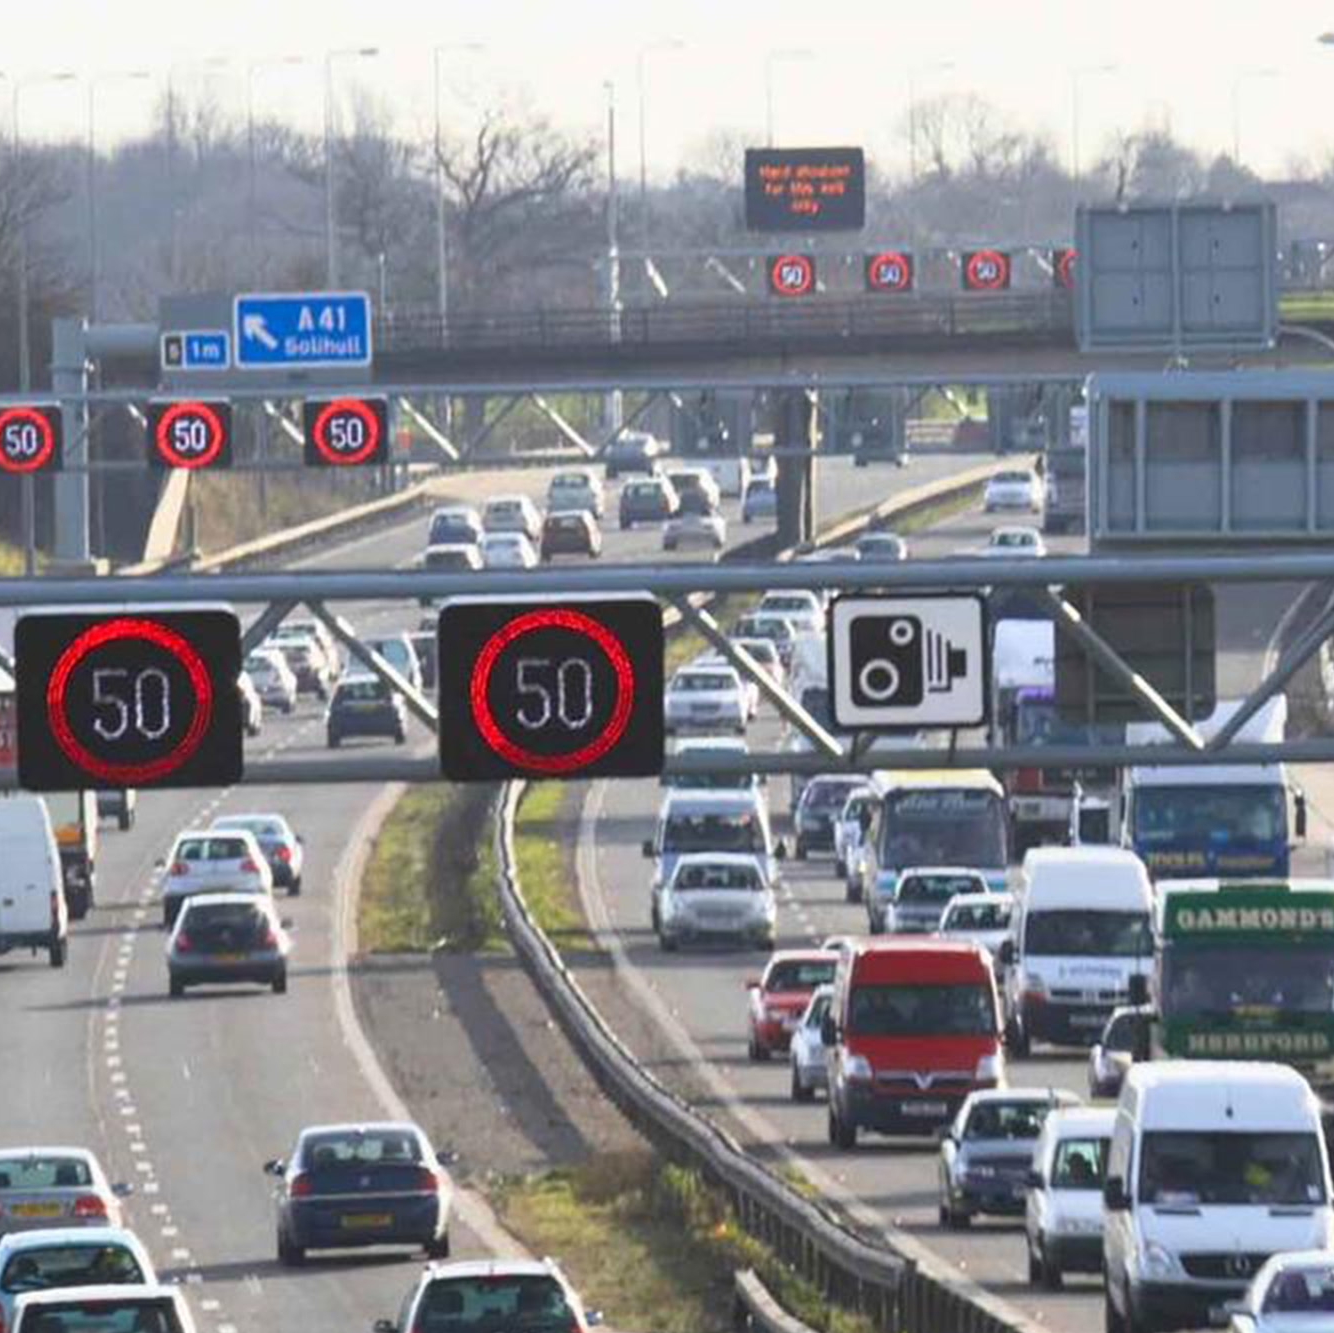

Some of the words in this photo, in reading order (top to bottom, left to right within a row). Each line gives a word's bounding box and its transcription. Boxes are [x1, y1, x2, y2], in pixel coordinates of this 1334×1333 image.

[284, 335, 361, 358] Solihull
[6, 425, 37, 455] 50
[174, 419, 206, 451] 50
[330, 418, 363, 449] 50
[93, 669, 170, 740] 50
[516, 658, 593, 730] 50
